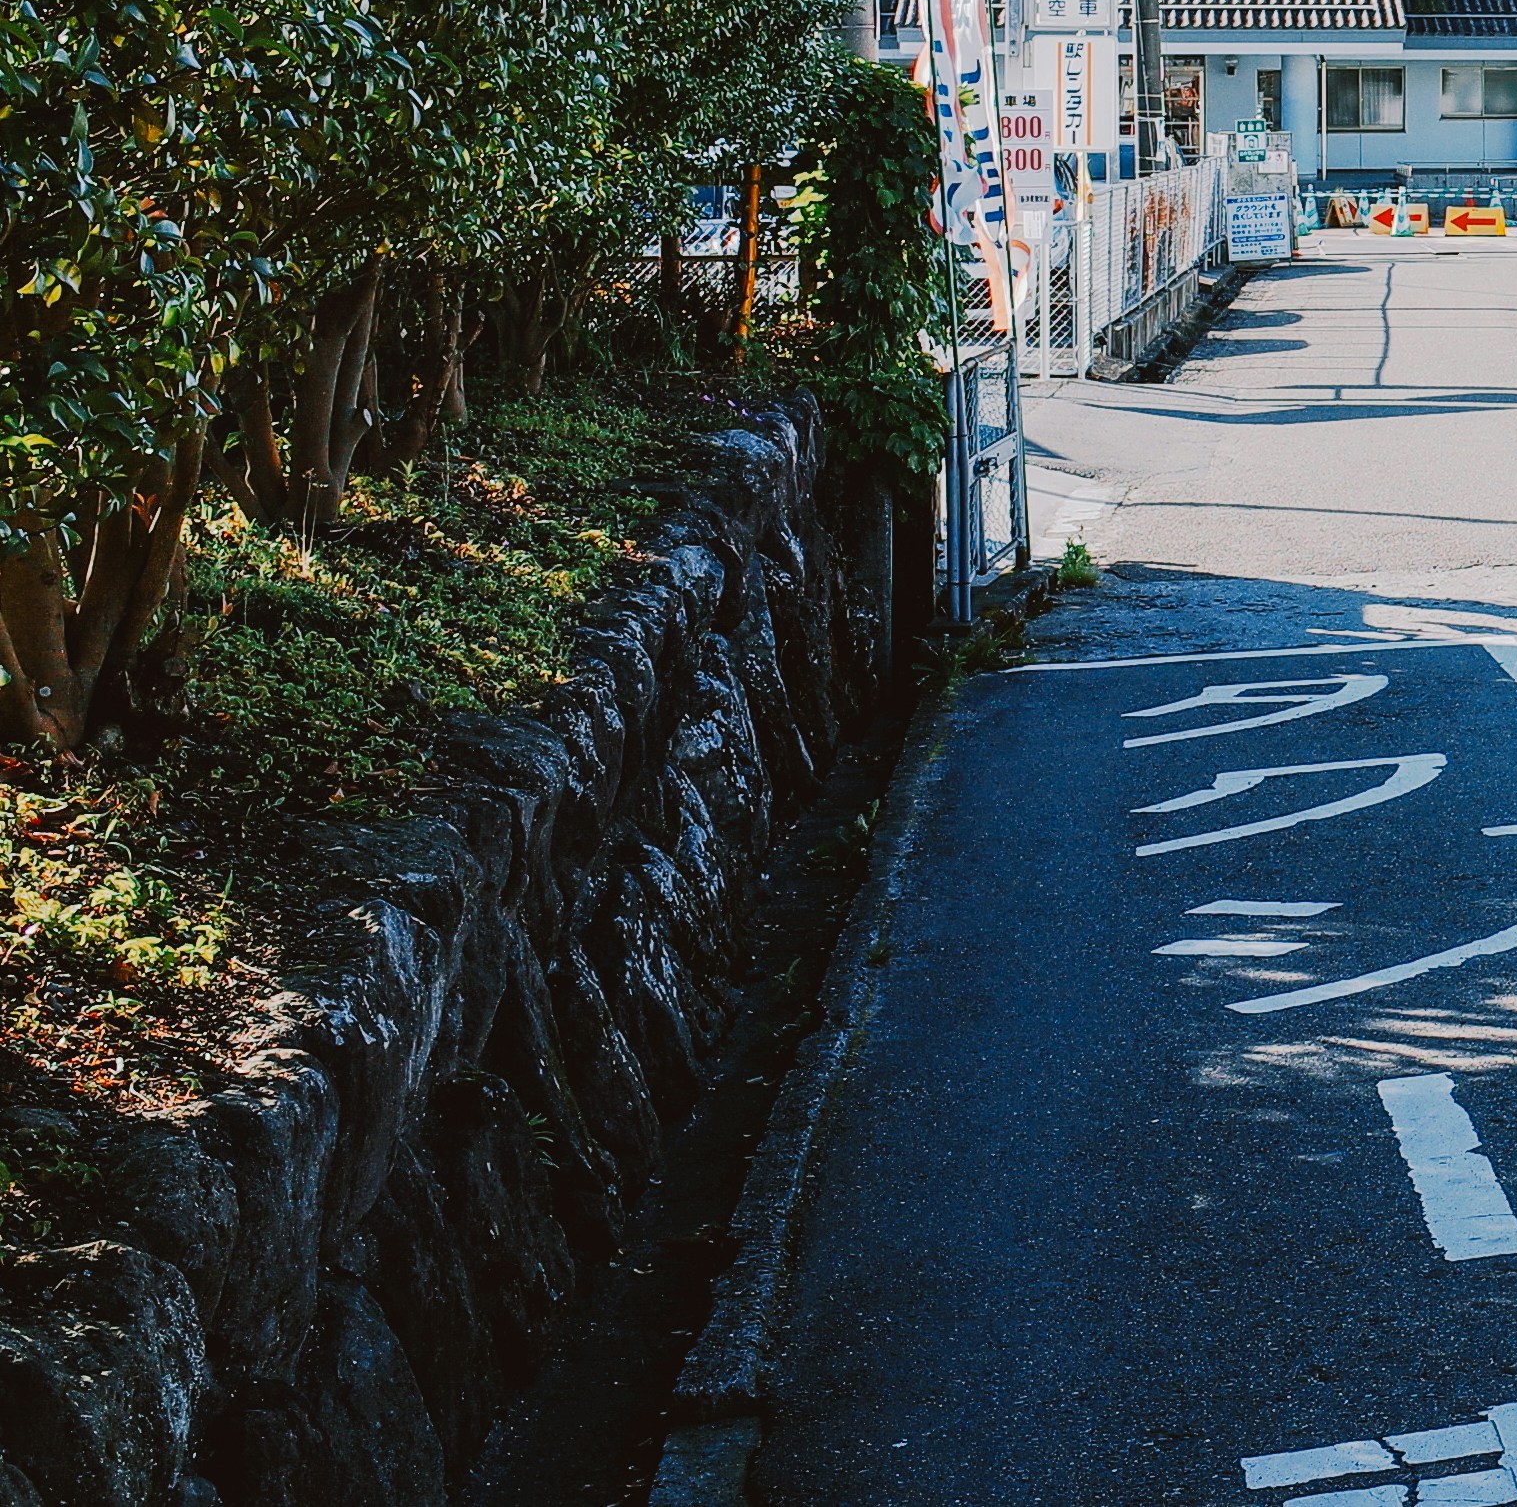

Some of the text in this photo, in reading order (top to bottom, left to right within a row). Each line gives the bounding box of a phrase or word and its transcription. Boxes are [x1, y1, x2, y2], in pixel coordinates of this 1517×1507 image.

[1063, 42, 1084, 146] 駅レンタカー
